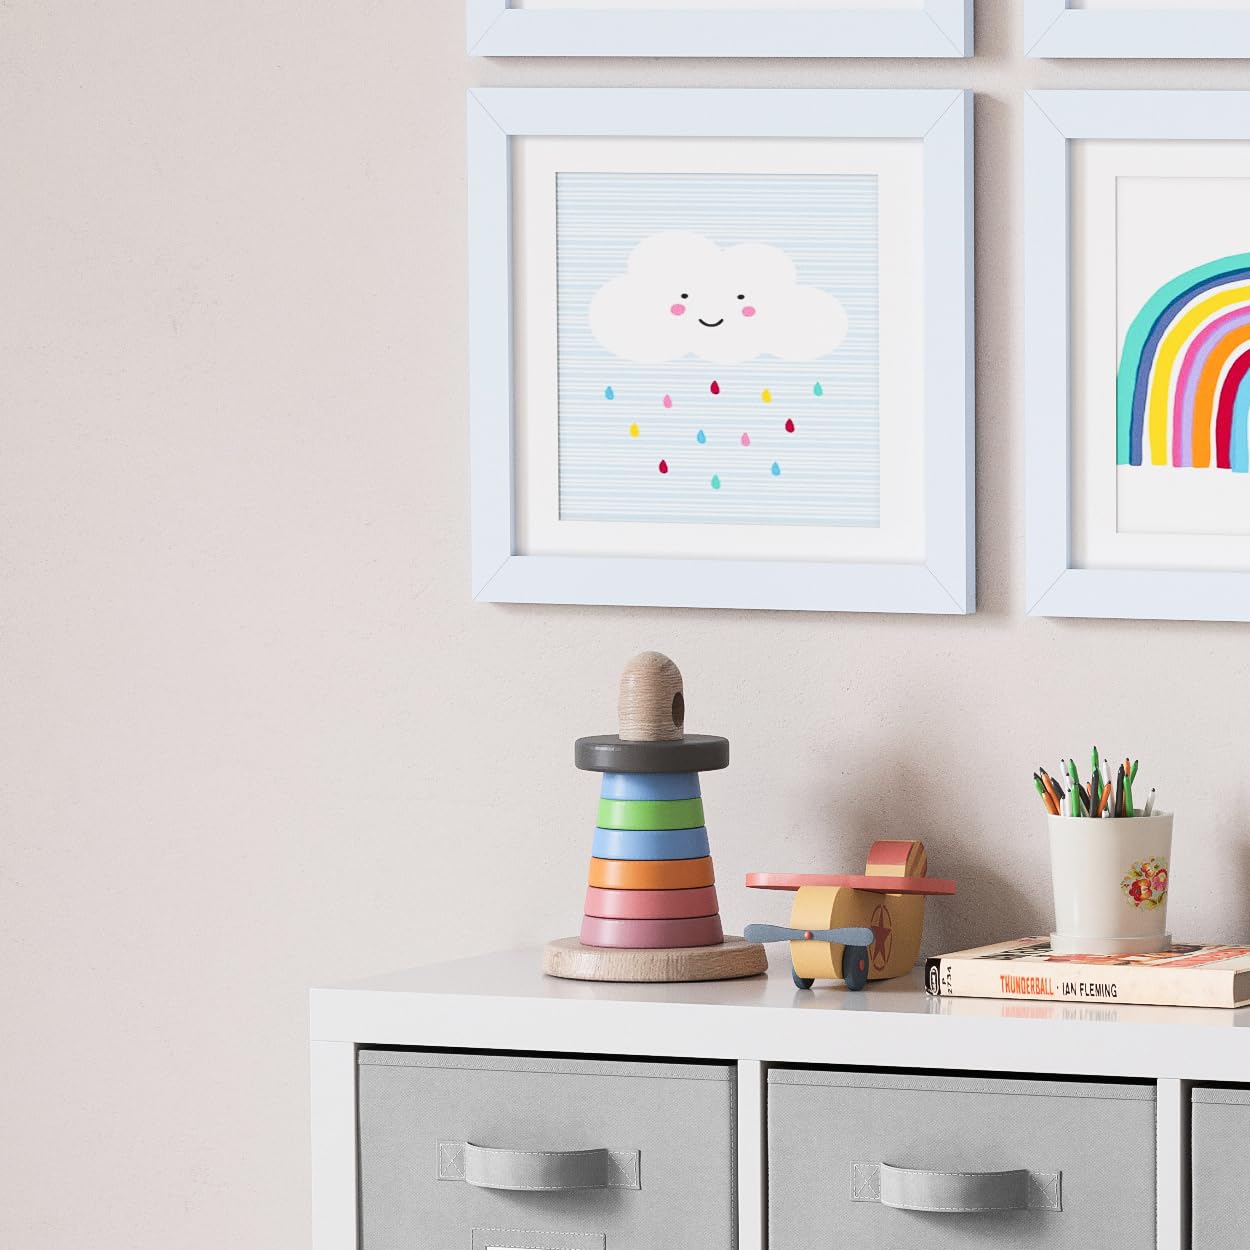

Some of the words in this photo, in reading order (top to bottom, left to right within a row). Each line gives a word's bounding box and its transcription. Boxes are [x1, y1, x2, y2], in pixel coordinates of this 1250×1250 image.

[999, 975, 1055, 996] THUNDERBALL
[1062, 982, 1077, 997] IAN
[1079, 982, 1118, 998] FLEMING
